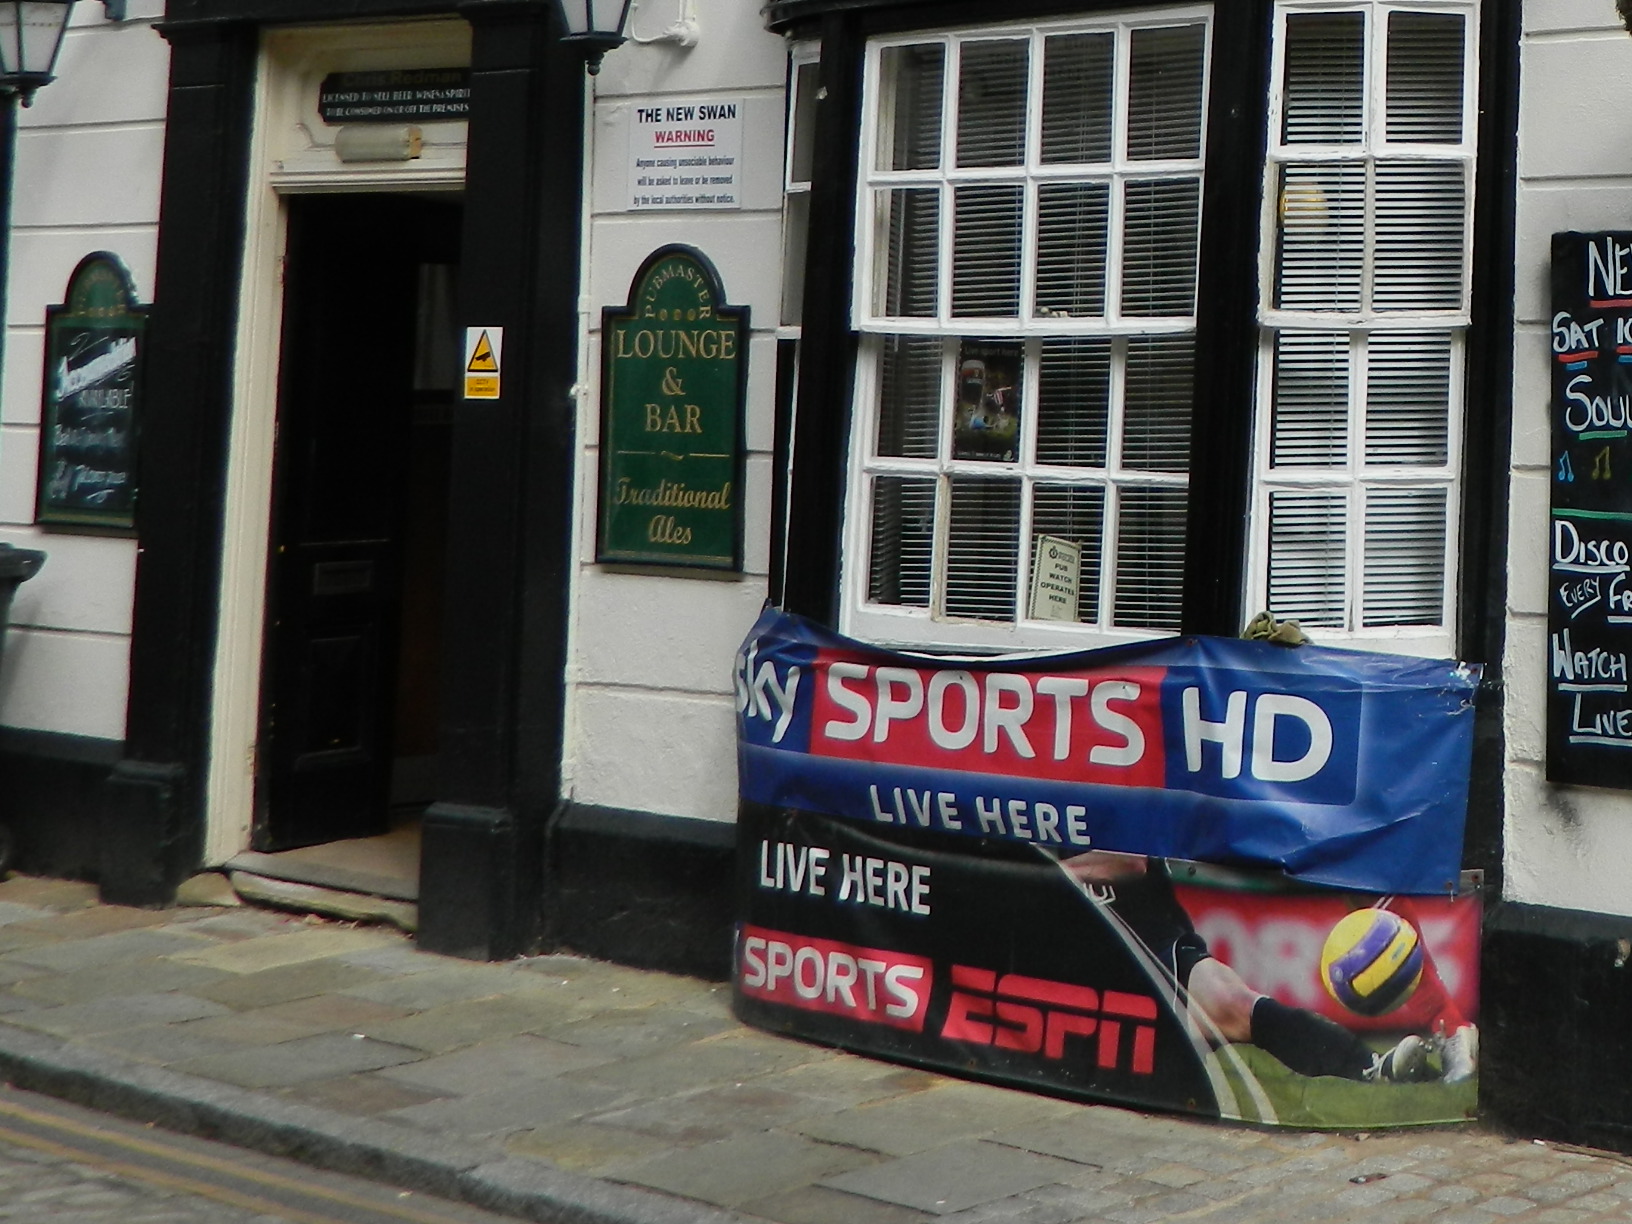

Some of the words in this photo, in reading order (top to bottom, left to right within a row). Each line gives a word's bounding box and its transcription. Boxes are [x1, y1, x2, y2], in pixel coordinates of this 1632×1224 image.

[637, 108, 662, 123] THE
[666, 106, 695, 122] NEW
[698, 104, 736, 120] SWAN
[655, 129, 715, 144] WARNING
[644, 265, 712, 319] PUBMASTER
[616, 329, 737, 360] LOUNGE
[1553, 311, 1604, 353] SAT
[661, 366, 686, 396] &
[644, 403, 703, 434] BAR
[614, 476, 732, 510] Traditional
[648, 513, 693, 545] Ales
[1554, 520, 1629, 566] DISCO
[1049, 572, 1072, 584] WATCH
[1054, 563, 1068, 573] PUB
[1040, 581, 1075, 596] OPERATES
[1049, 594, 1067, 605] HERE
[1558, 576, 1602, 608] EVERY
[1552, 628, 1628, 682] WATCH
[824, 662, 1146, 768] SPORTS
[1182, 686, 1335, 783] HD
[870, 784, 962, 831] LIVE
[976, 797, 1092, 847] HERE
[759, 839, 831, 896] LIVE
[840, 854, 931, 916] HERE
[744, 936, 924, 1019] SPORTS
[940, 964, 1157, 1074] ESPN
